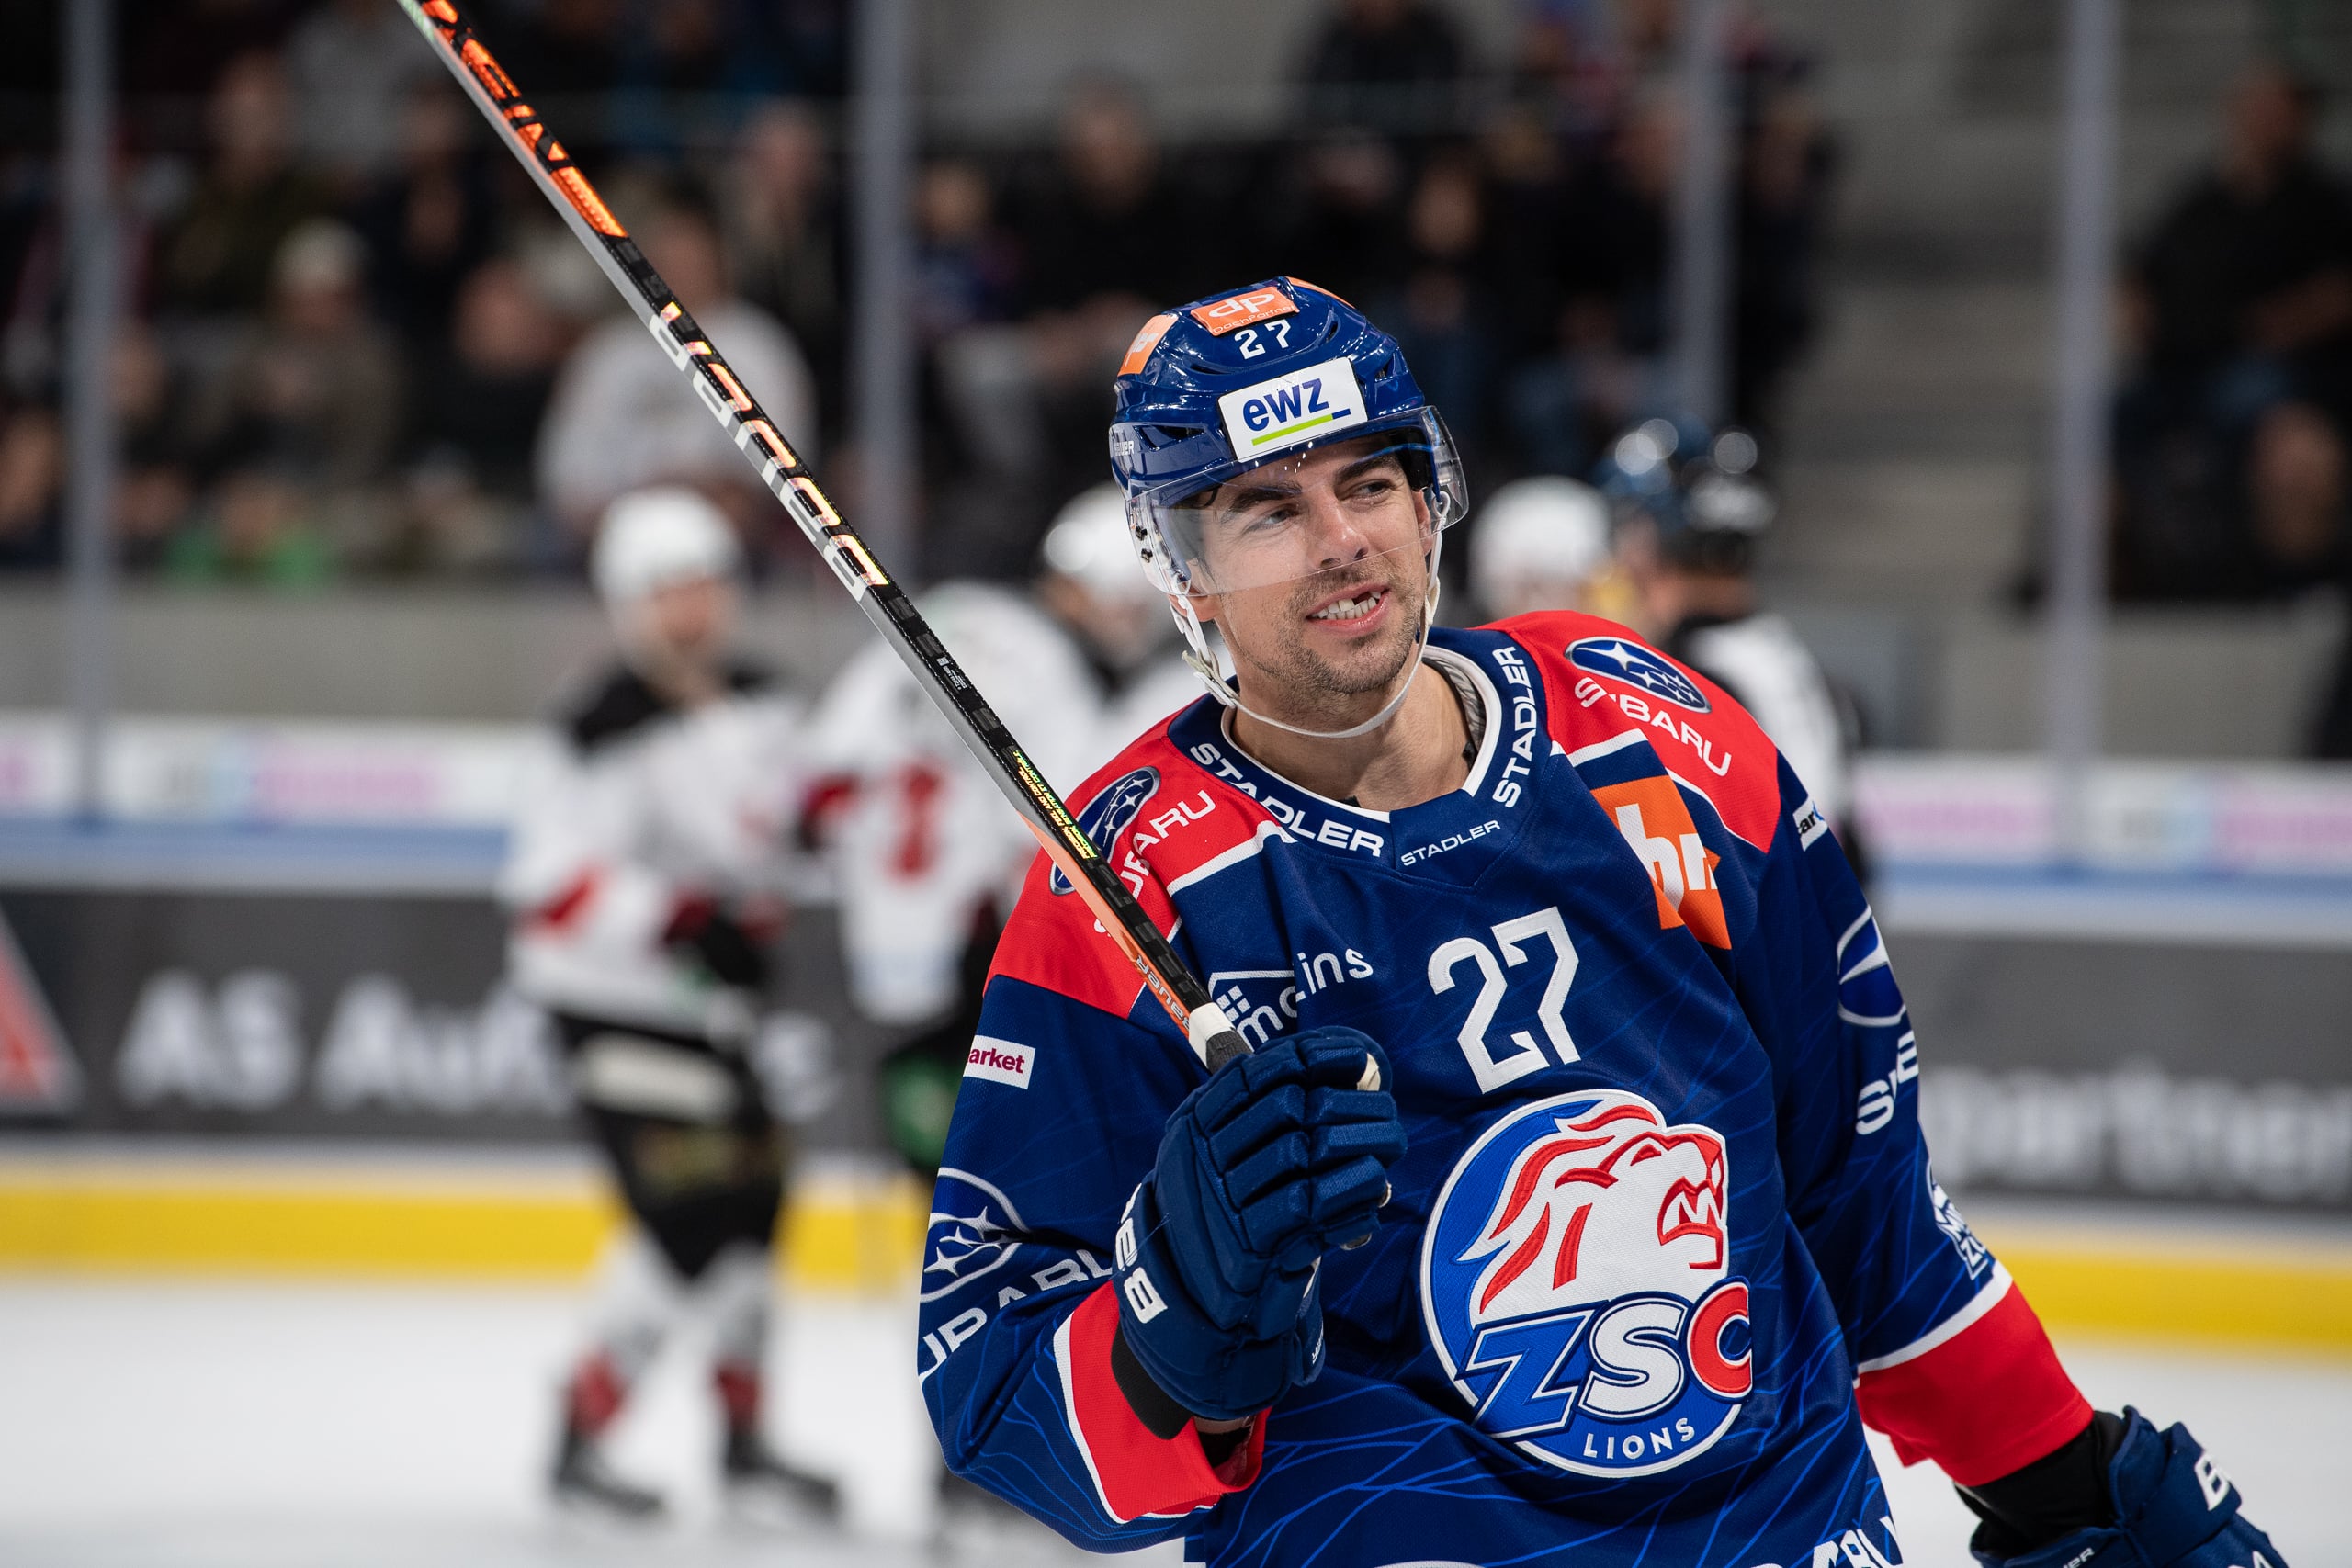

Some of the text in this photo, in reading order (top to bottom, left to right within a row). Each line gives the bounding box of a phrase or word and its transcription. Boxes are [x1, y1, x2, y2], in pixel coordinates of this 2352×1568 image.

[1234, 319, 1291, 360] 27
[1491, 646, 1537, 808] STADLER
[1575, 677, 1732, 777] SBARU
[1190, 742, 1384, 857] STADLER
[1401, 820, 1501, 866] STADLER
[1428, 907, 1579, 1093] 27
[1468, 1275, 1753, 1439] ZSC
[1583, 1417, 1695, 1460] LIONS
